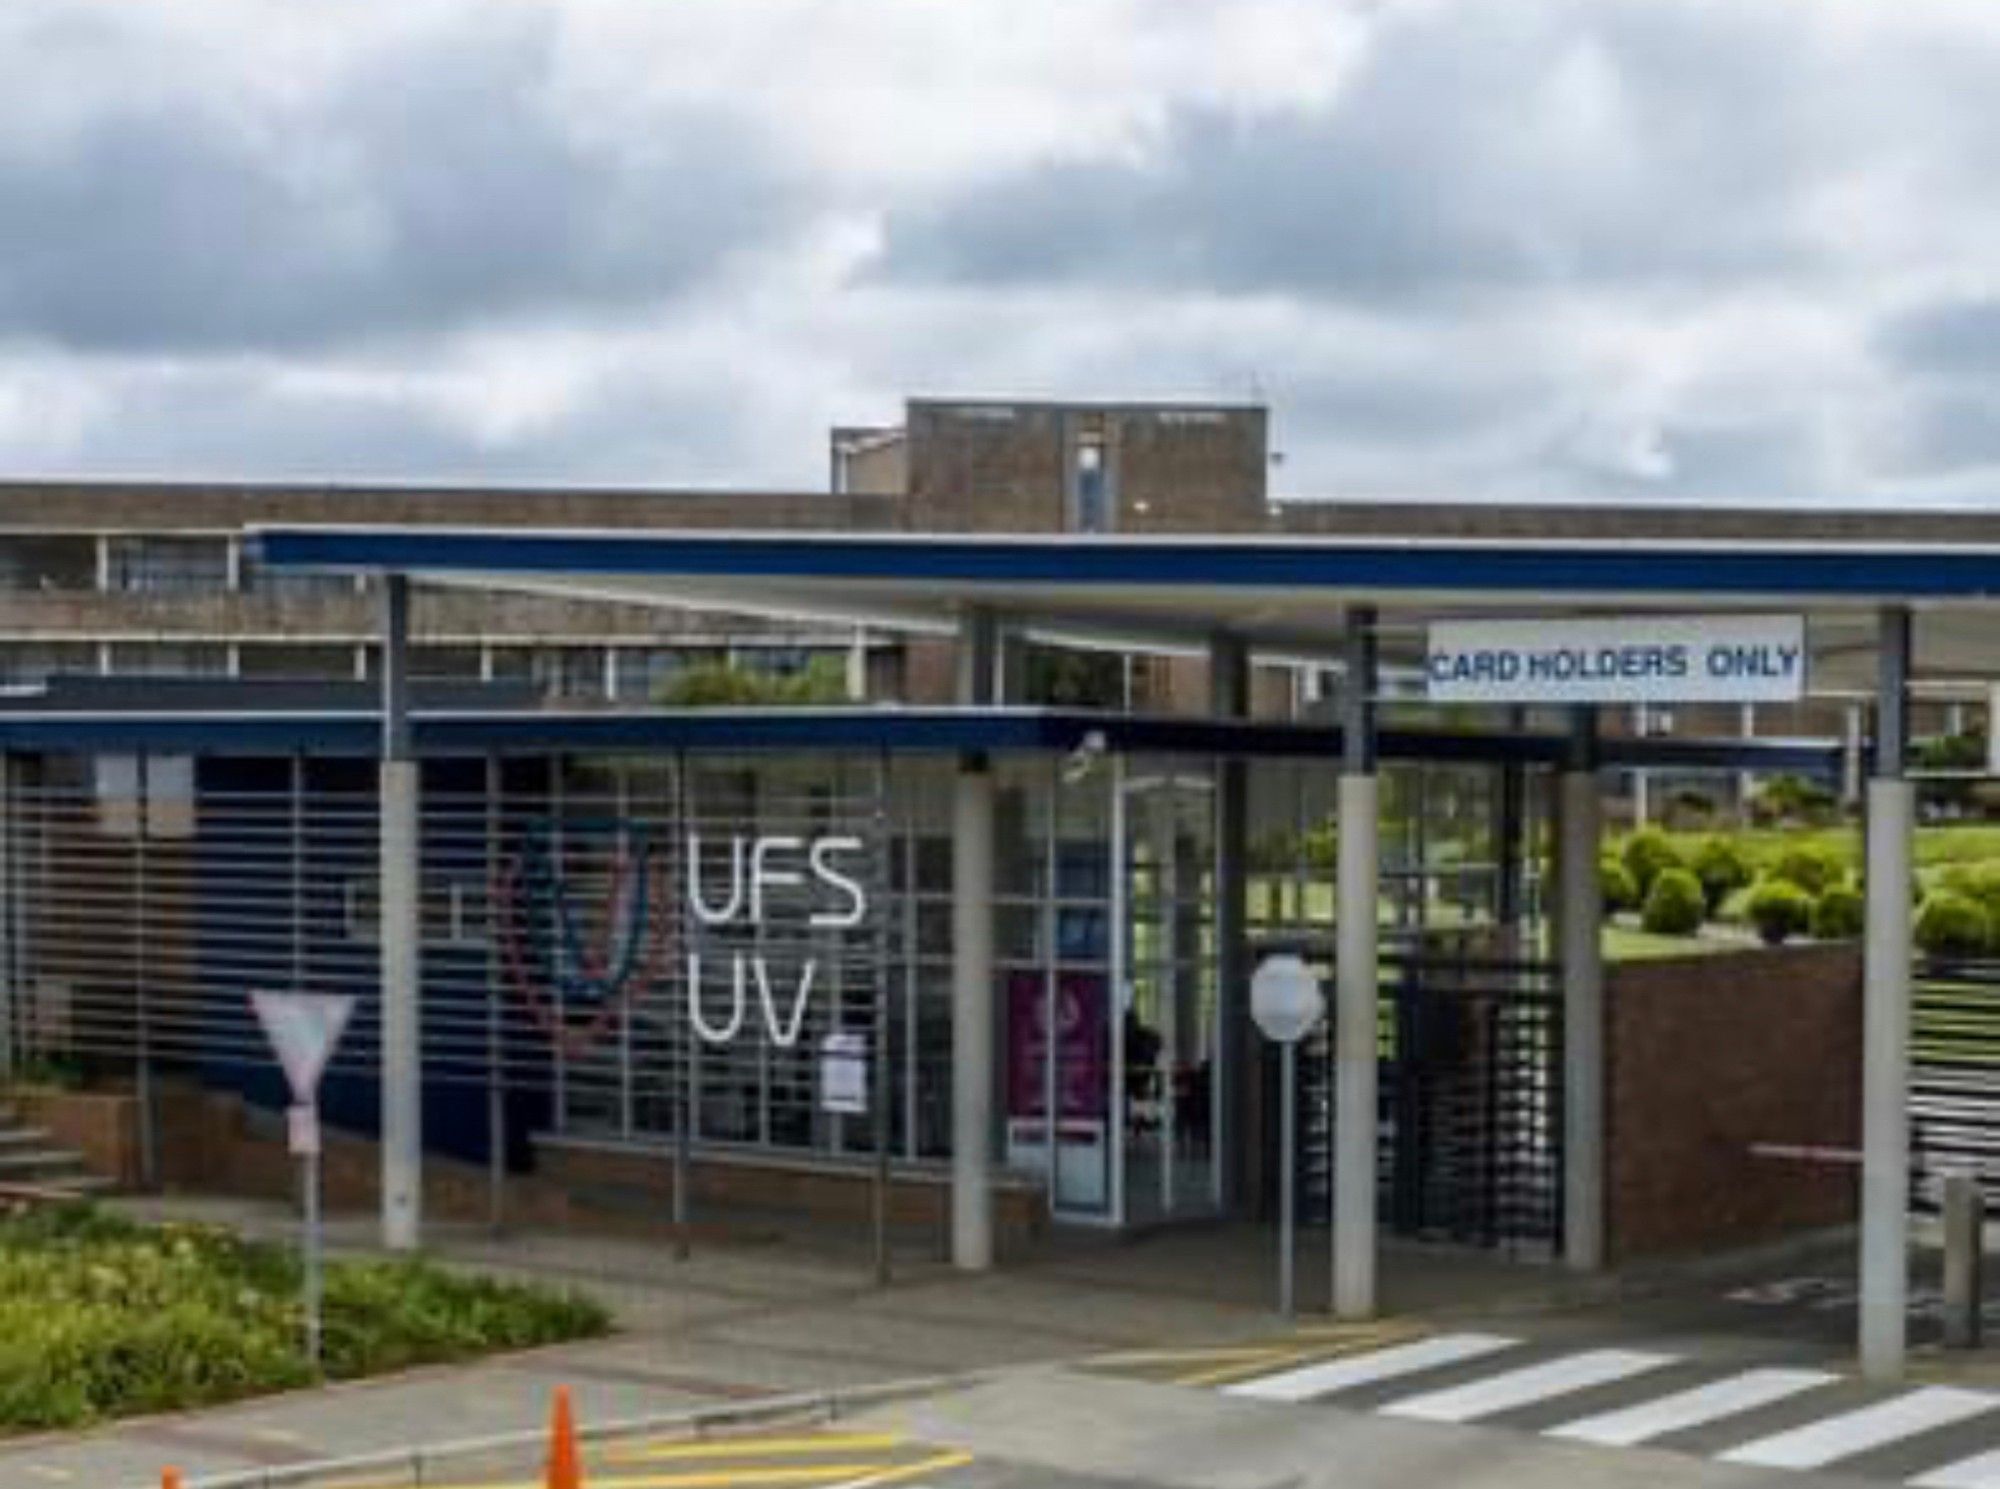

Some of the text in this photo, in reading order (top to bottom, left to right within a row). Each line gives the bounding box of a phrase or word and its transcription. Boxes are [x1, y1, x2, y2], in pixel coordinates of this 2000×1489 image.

[1429, 643, 1798, 681] CARD HOLDERS ONLY
[688, 833, 866, 925] UFS
[688, 951, 816, 1046] UV
